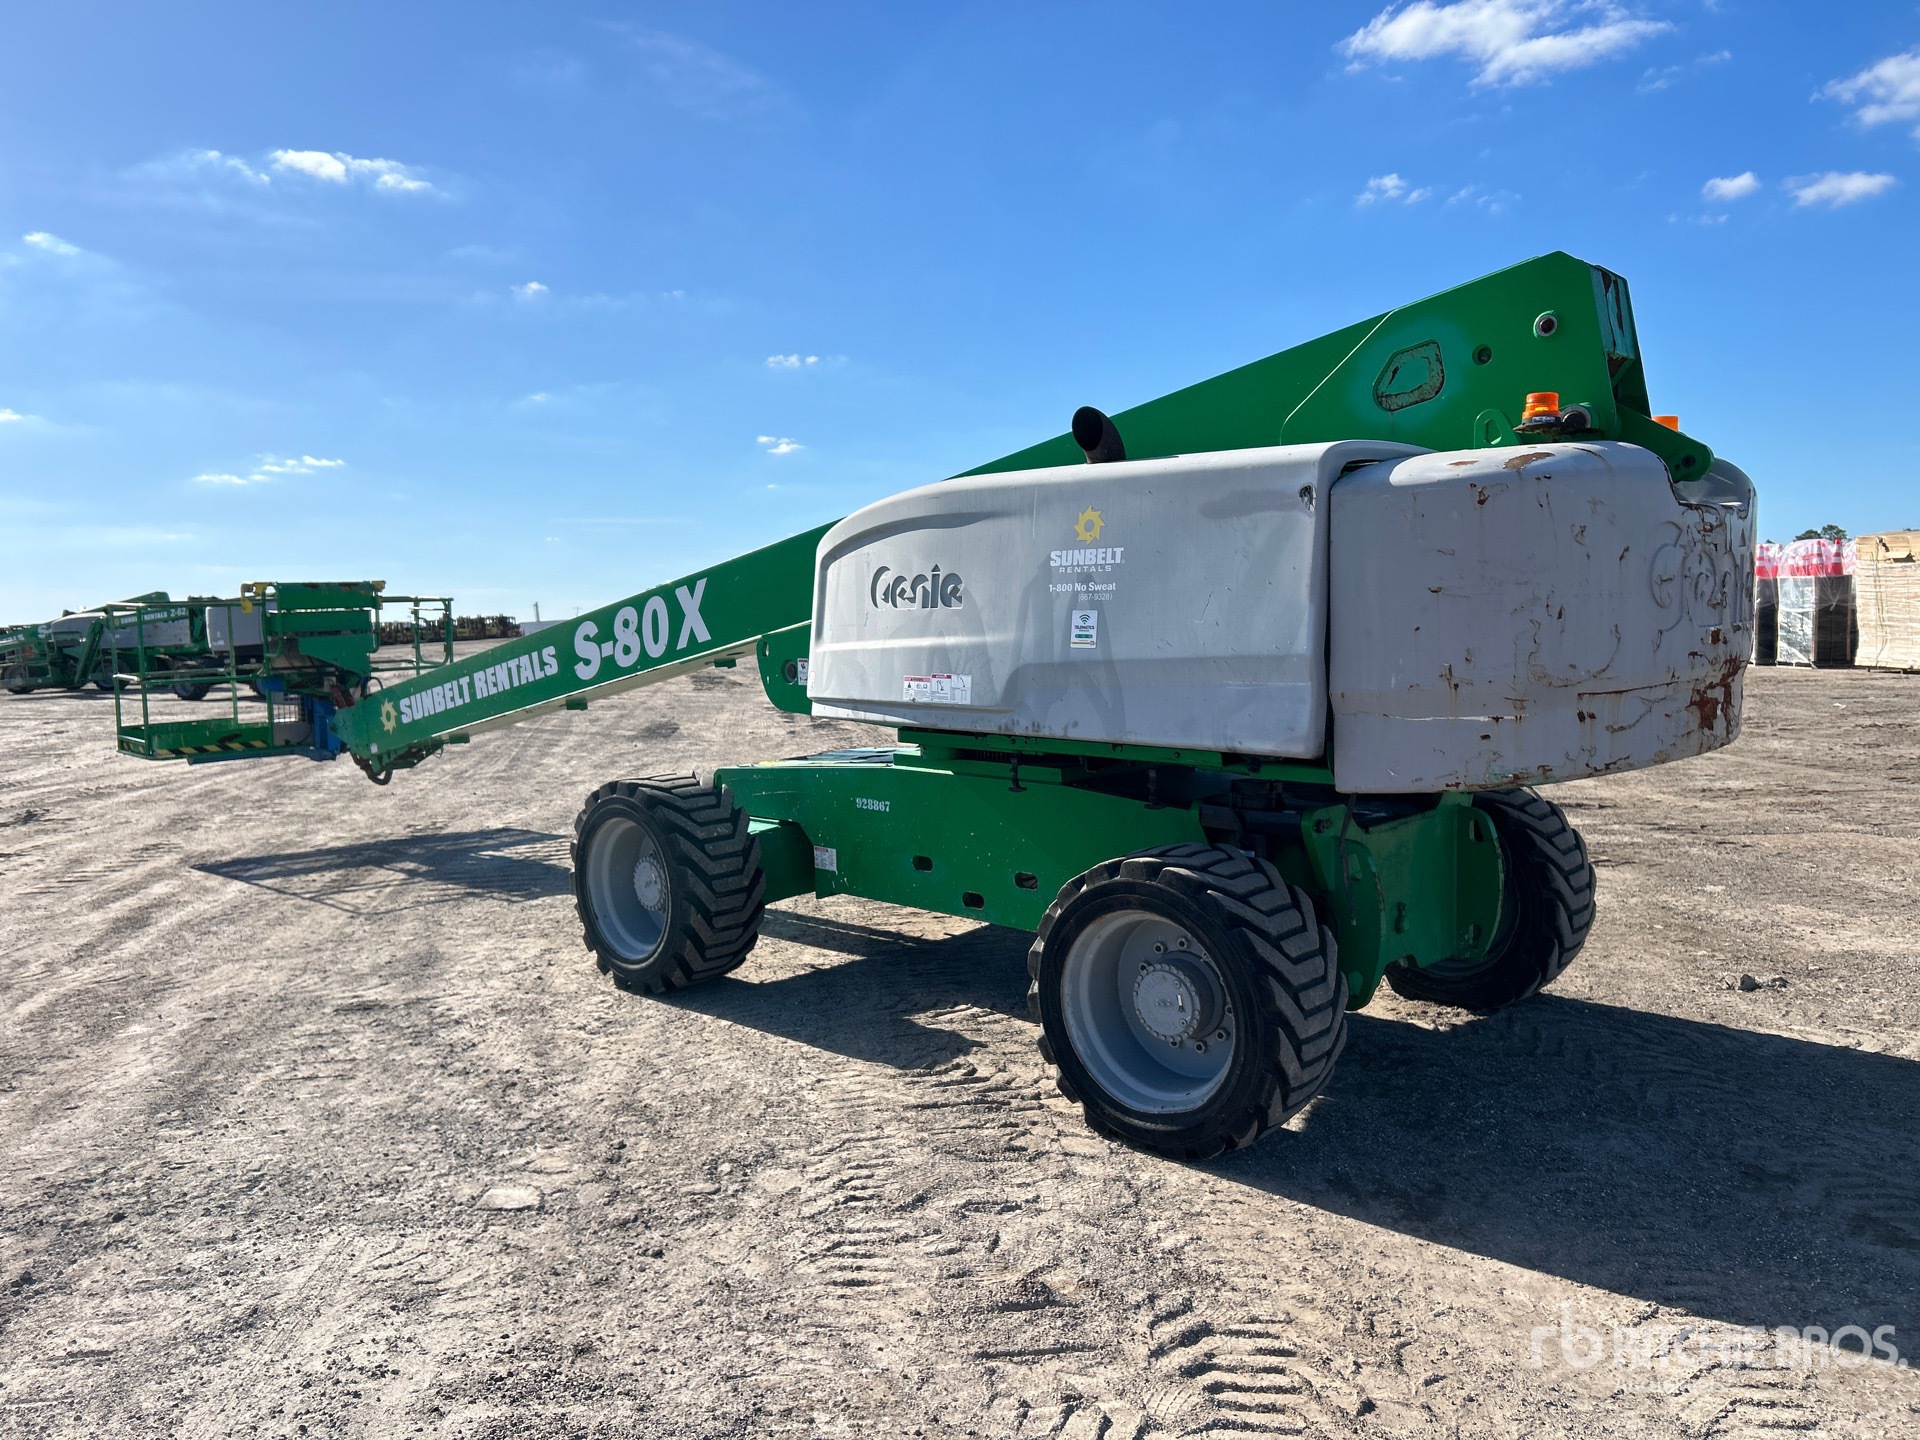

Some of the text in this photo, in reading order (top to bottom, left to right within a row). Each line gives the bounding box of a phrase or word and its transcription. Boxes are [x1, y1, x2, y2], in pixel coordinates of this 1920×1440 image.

[1050, 547, 1125, 567] SUNBELT
[1059, 565, 1112, 573] RENTALS
[870, 563, 964, 610] Genie
[1048, 581, 1117, 592] 1-800 No Sweat
[399, 675, 470, 725] SUNBELT
[474, 645, 559, 701] RENTALS
[856, 797, 891, 813] 928867
